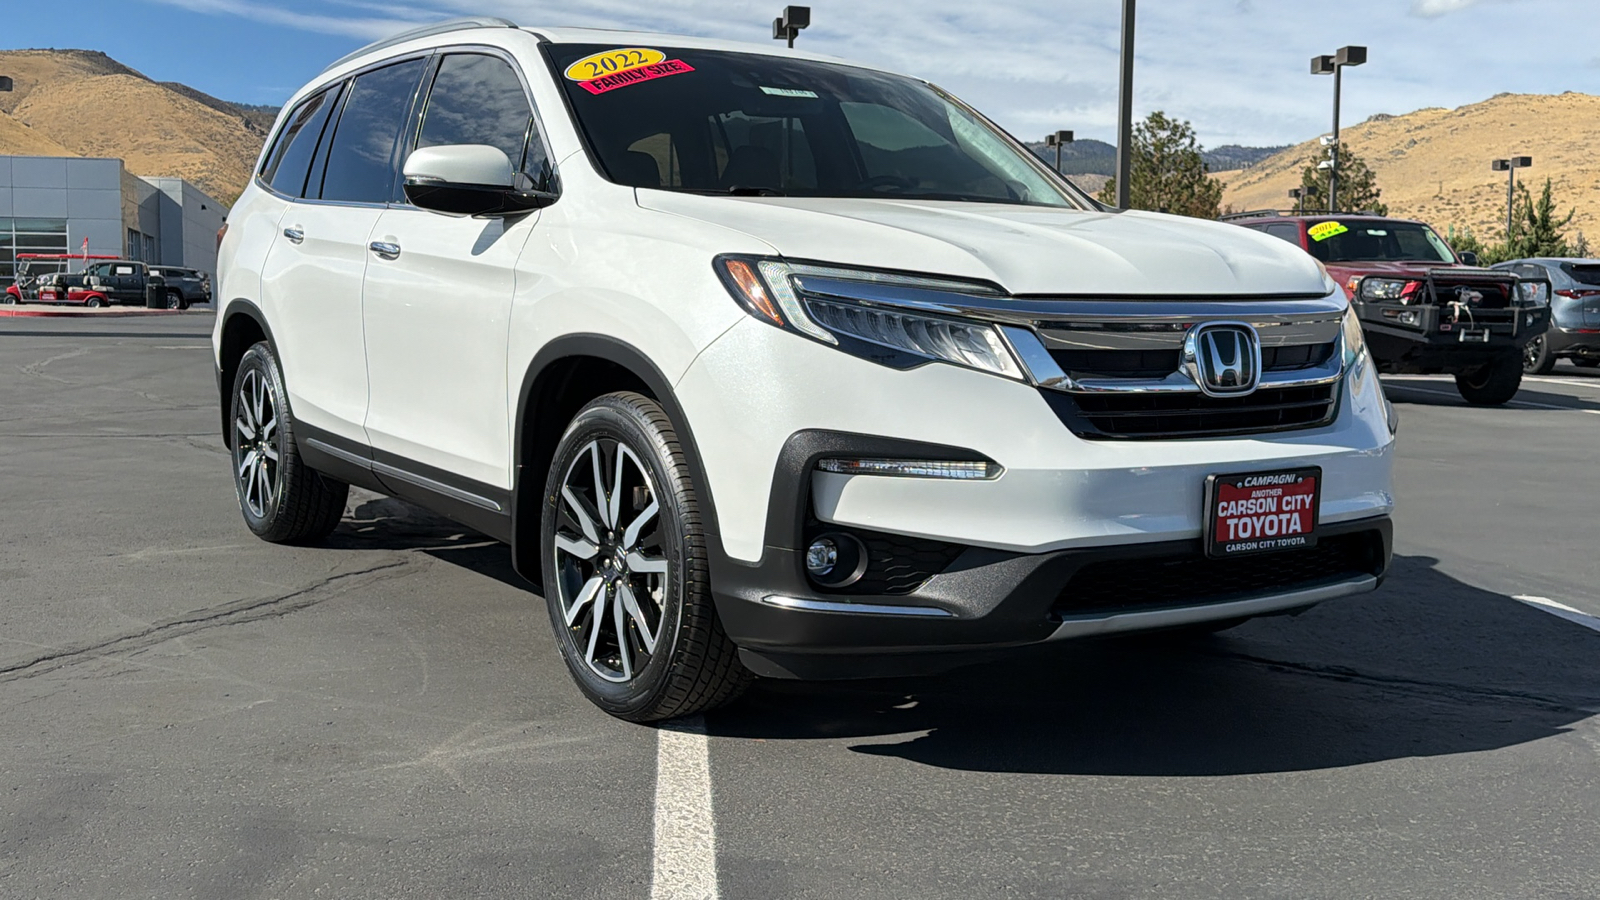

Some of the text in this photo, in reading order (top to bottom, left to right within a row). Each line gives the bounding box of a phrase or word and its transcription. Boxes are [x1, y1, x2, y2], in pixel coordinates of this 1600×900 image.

[584, 50, 648, 77] 2022
[590, 62, 682, 90] FAMILY SIZE
[1244, 474, 1296, 487] CAMPAGNI
[1251, 488, 1283, 498] ANOTHER
[1218, 494, 1313, 517] CARSON CITY
[1226, 512, 1302, 540] TOYOTA
[1226, 537, 1305, 552] CARSON CITY TOYOTA
